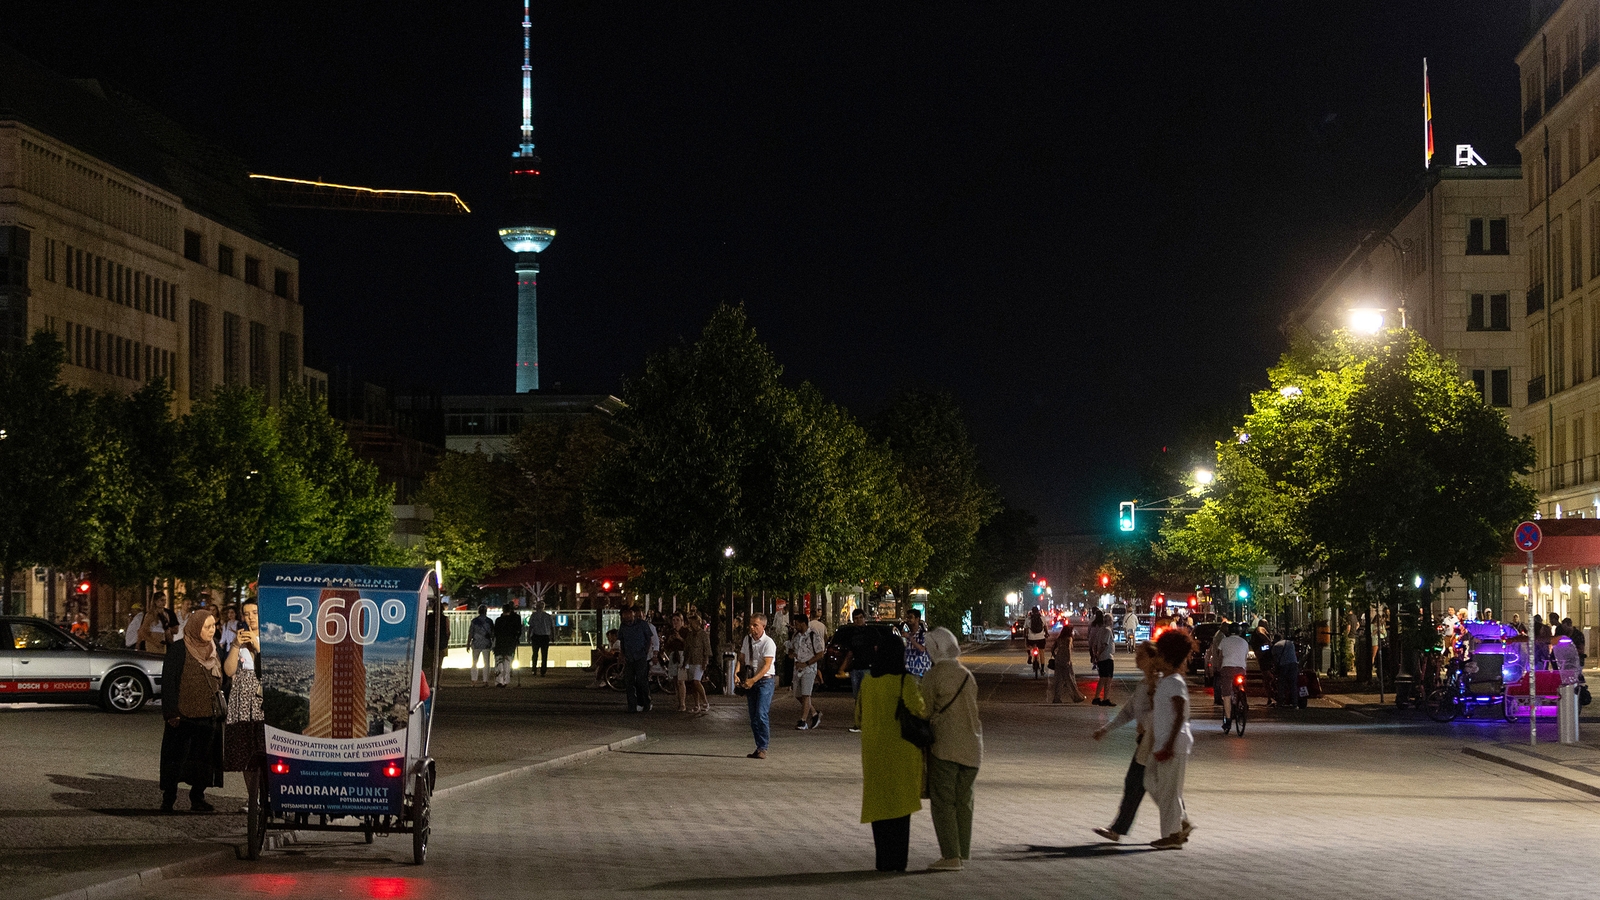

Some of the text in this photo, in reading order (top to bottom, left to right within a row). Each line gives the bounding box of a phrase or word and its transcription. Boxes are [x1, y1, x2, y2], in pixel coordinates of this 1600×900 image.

[275, 575, 400, 585] PANORAMAPUNKT
[557, 615, 567, 625] U
[271, 734, 338, 751] AUSSICHTSPLATTFORM
[356, 738, 398, 750] AUSSTELLUNG
[270, 744, 401, 760] VIEWING PLATTFORM CAFÉ EXHIBITION
[280, 784, 389, 797] PANORAMAPUNKT
